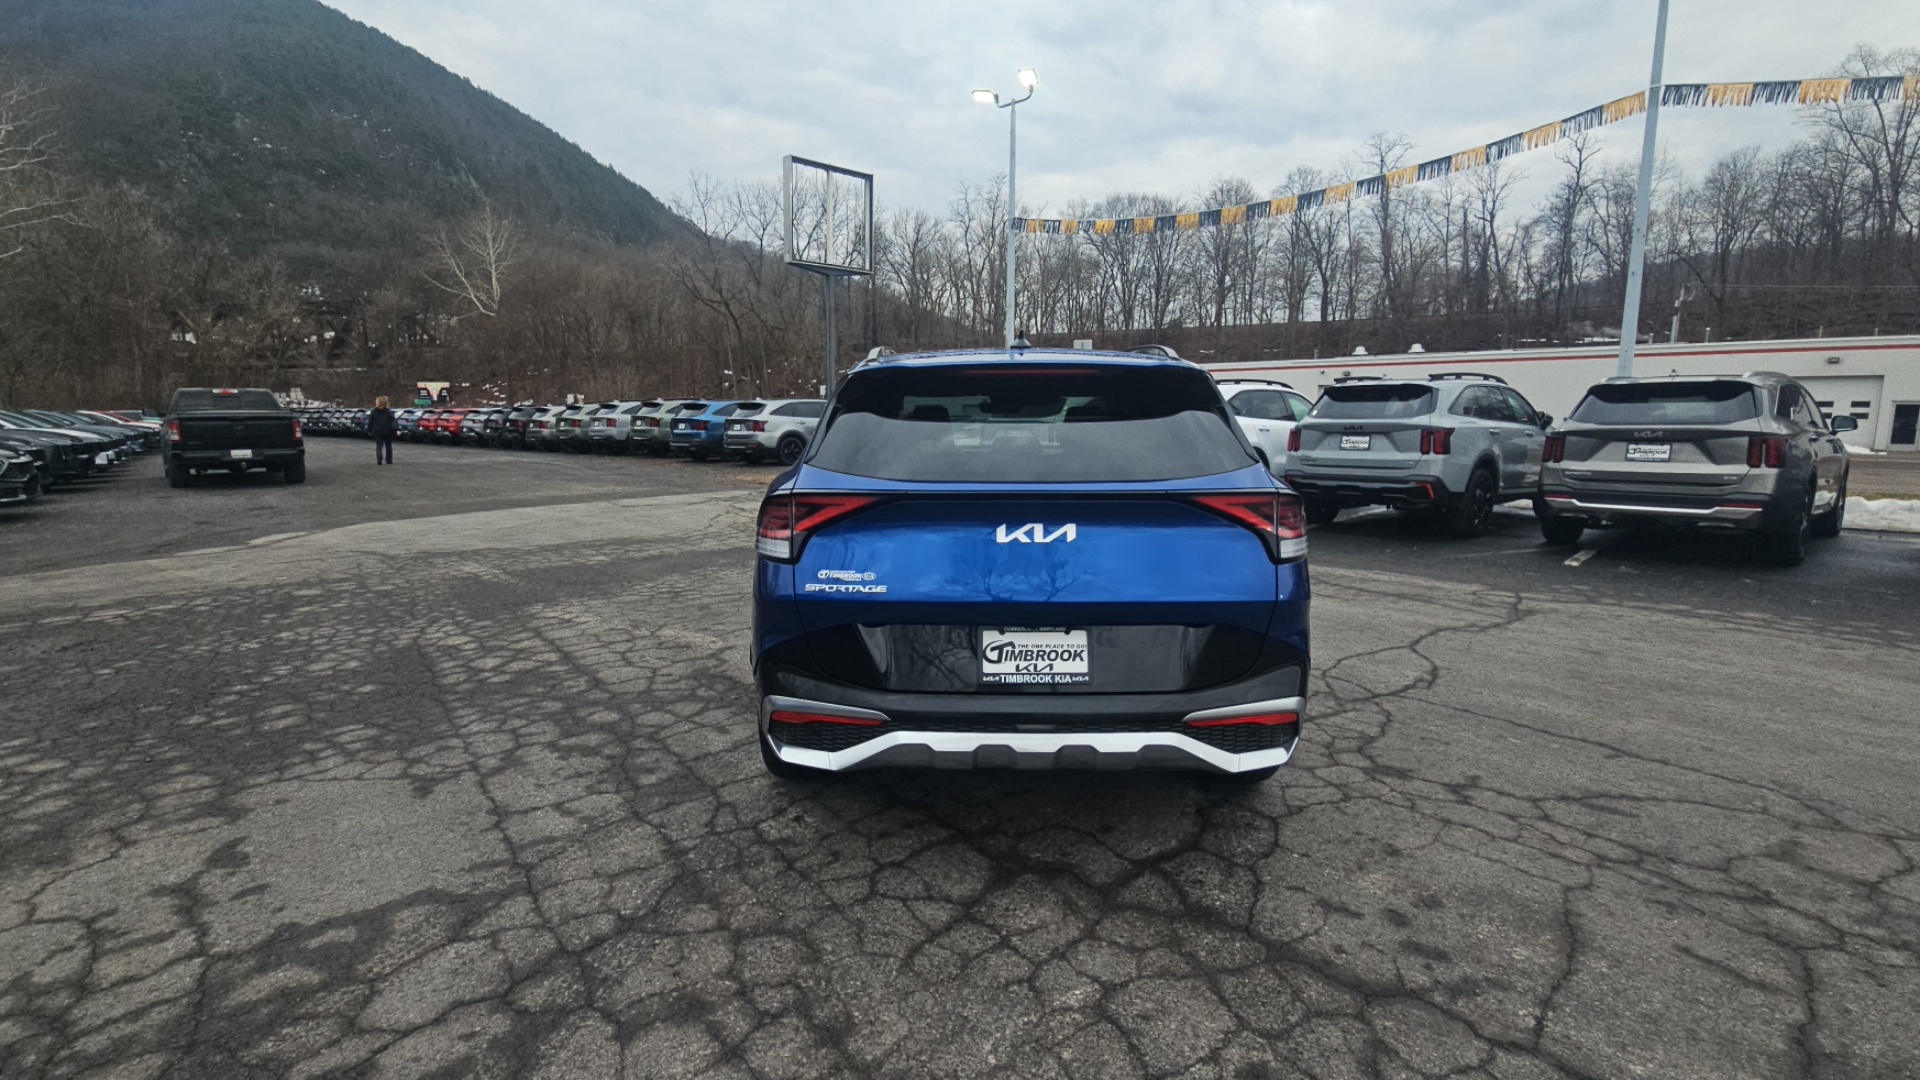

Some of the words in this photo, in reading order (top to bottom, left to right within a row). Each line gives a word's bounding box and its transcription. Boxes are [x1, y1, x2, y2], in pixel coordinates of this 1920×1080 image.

[996, 523, 1076, 543] KIA
[805, 584, 887, 593] SPORTAGE
[983, 640, 1086, 664] TIMBROOK
[1015, 663, 1053, 672] KIA
[1000, 674, 1053, 683] TIMBROOK
[1055, 674, 1072, 683] KIA
